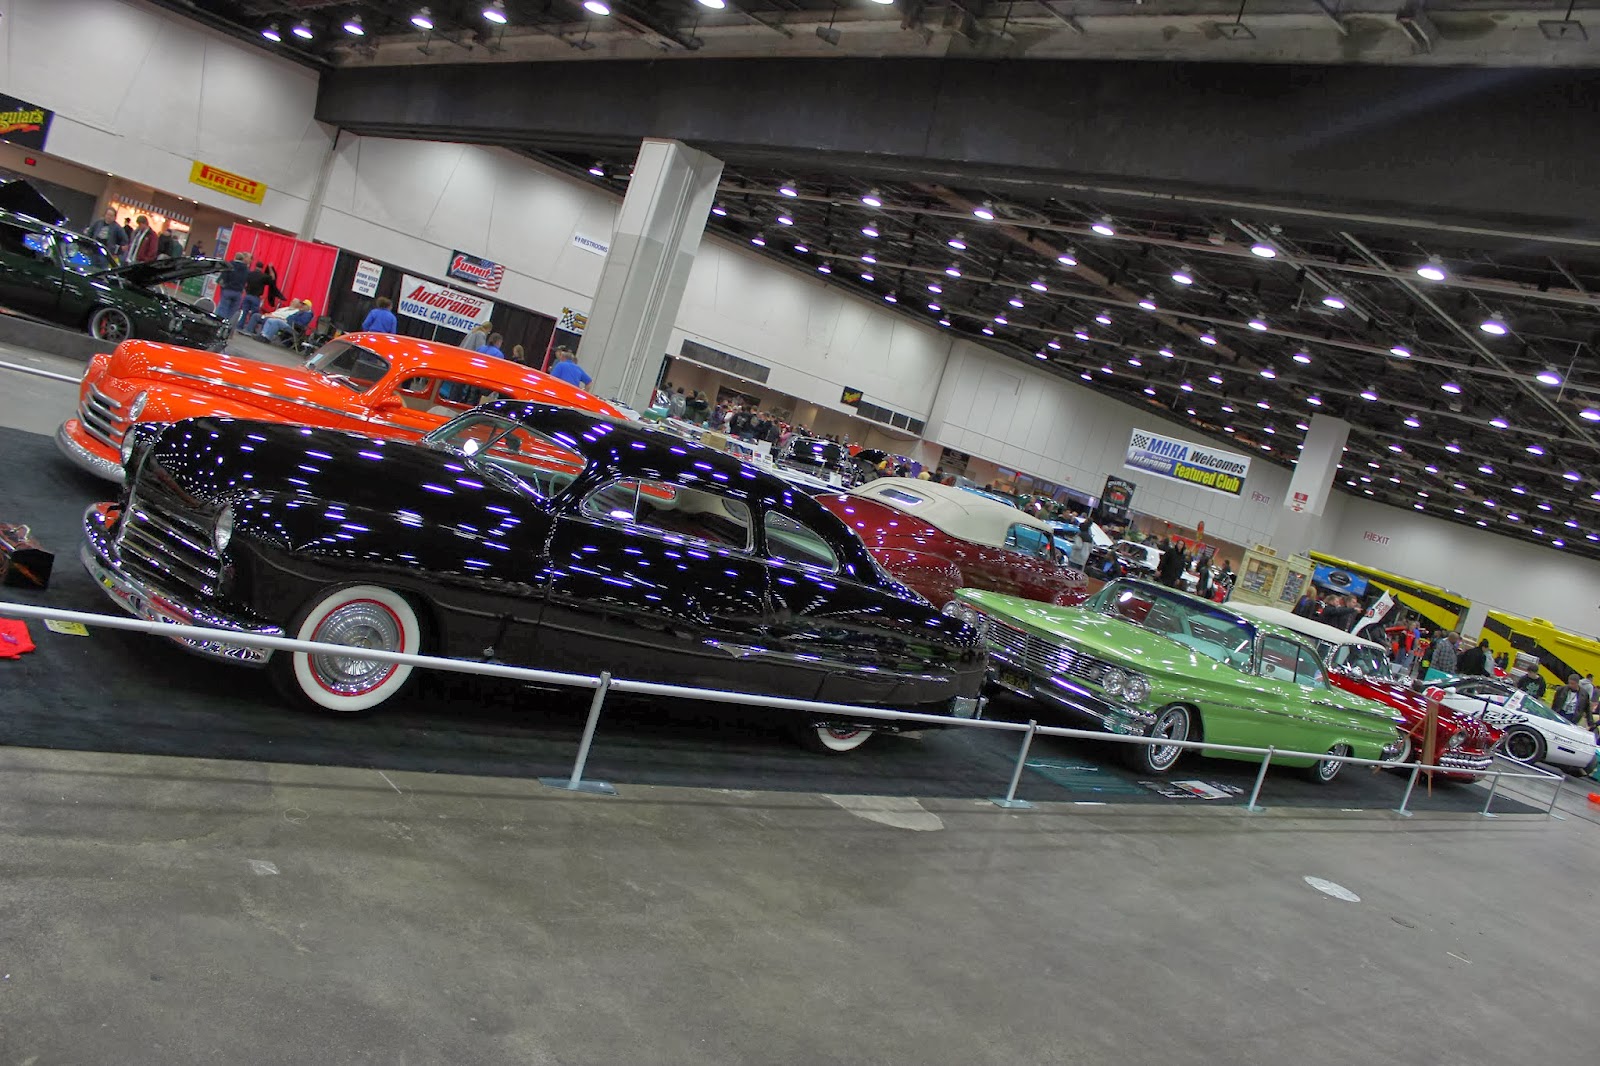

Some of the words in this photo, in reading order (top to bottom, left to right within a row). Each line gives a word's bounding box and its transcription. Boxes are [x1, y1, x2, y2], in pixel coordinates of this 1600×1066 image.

[0, 109, 44, 129] guiar's
[200, 165, 258, 195] PIRELLI
[580, 238, 608, 253] RESTROOMS
[452, 255, 492, 278] SUMMIT
[407, 285, 481, 318] Autorama
[441, 290, 484, 306] DETROIT
[401, 301, 428, 317] MODEL
[430, 310, 447, 323] CAR
[447, 316, 480, 330] CONTE
[1128, 452, 1173, 473] Autorama
[1147, 438, 1188, 461] MHRA
[1190, 450, 1246, 474] Welcomes
[1173, 463, 1217, 486] Featured
[1216, 474, 1240, 492] Club
[1371, 533, 1390, 545] EXIT
[1426, 687, 1446, 702] 16
